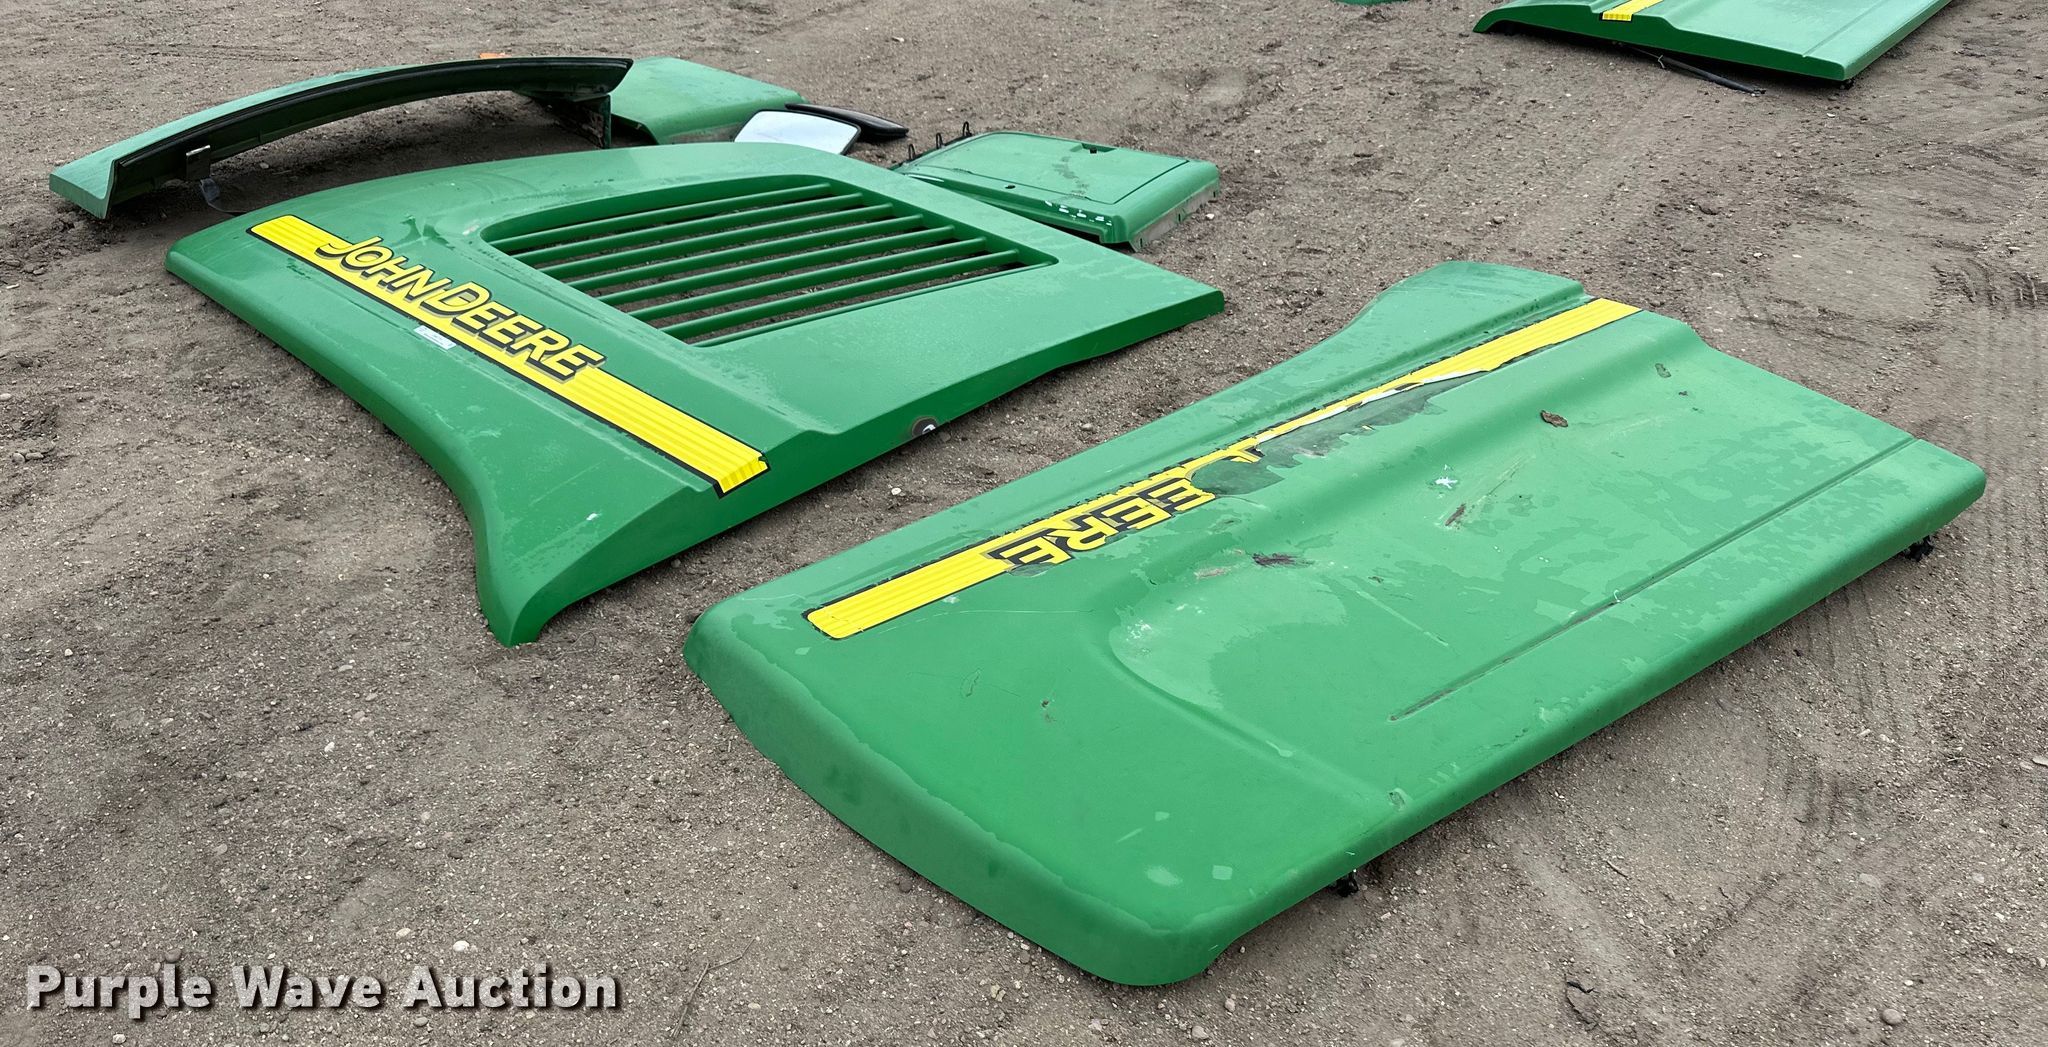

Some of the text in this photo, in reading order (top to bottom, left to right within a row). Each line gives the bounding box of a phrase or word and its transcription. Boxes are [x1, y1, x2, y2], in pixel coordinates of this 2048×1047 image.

[314, 236, 607, 383] JOHN DEERE
[990, 451, 1256, 565] EERE
